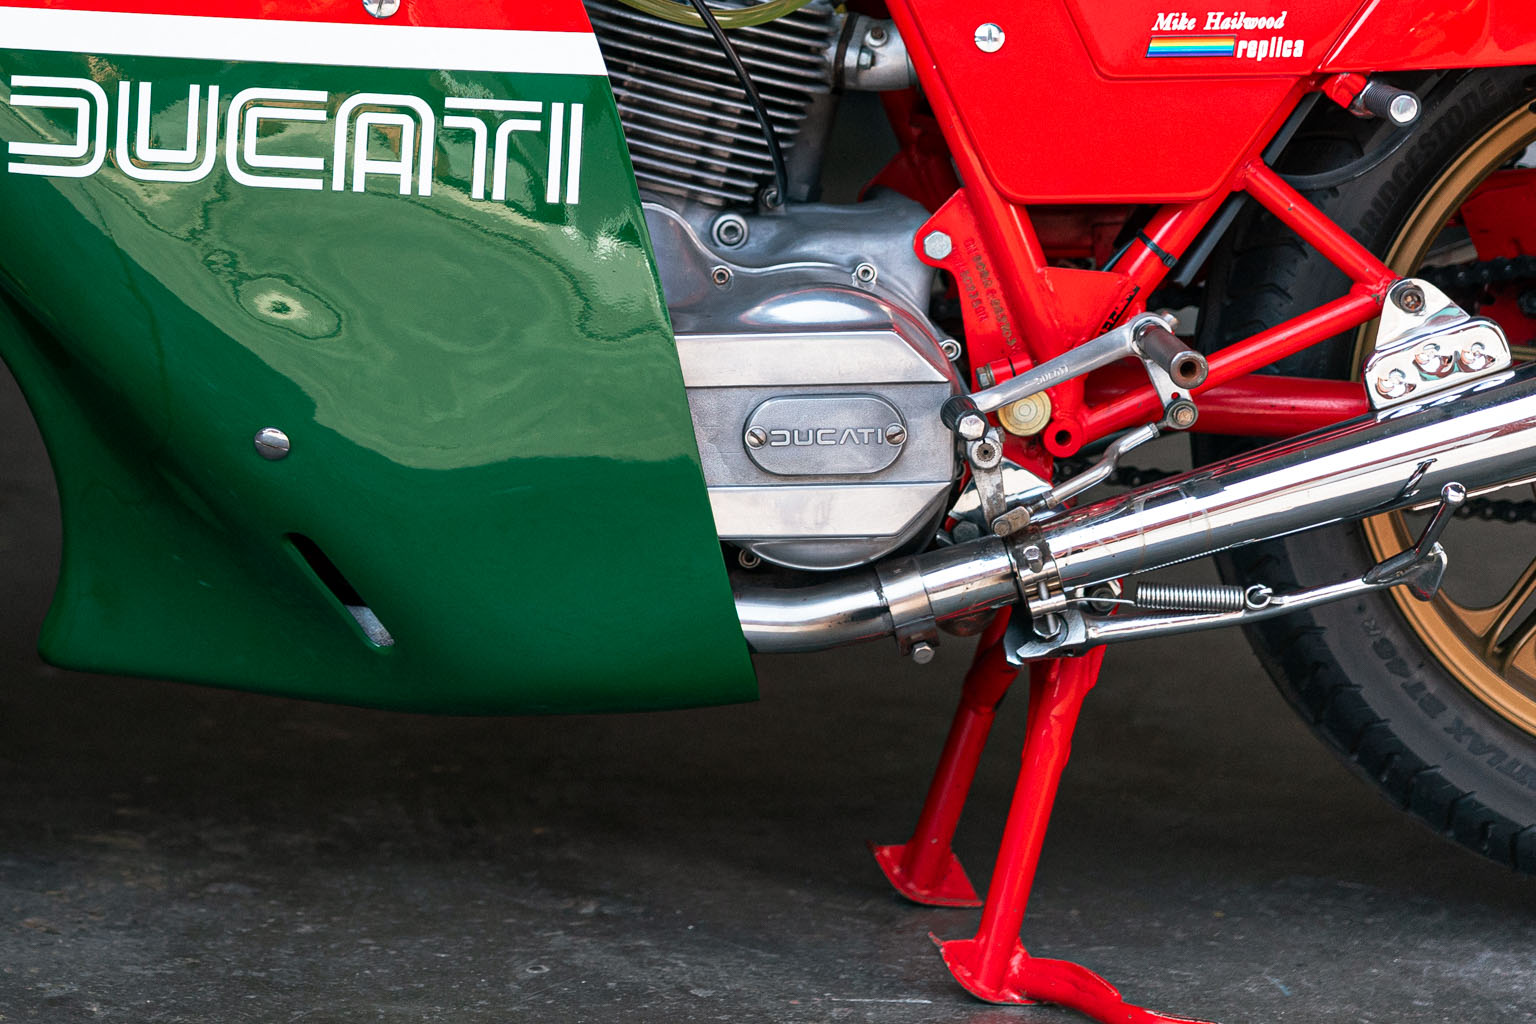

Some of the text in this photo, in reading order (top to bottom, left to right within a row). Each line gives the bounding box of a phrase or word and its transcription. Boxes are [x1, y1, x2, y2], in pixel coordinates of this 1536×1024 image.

[1151, 11, 1288, 31] Mike Hailwood
[1237, 36, 1304, 62] replica
[8, 74, 584, 205] DUCATI
[769, 428, 883, 447] DUCATI
